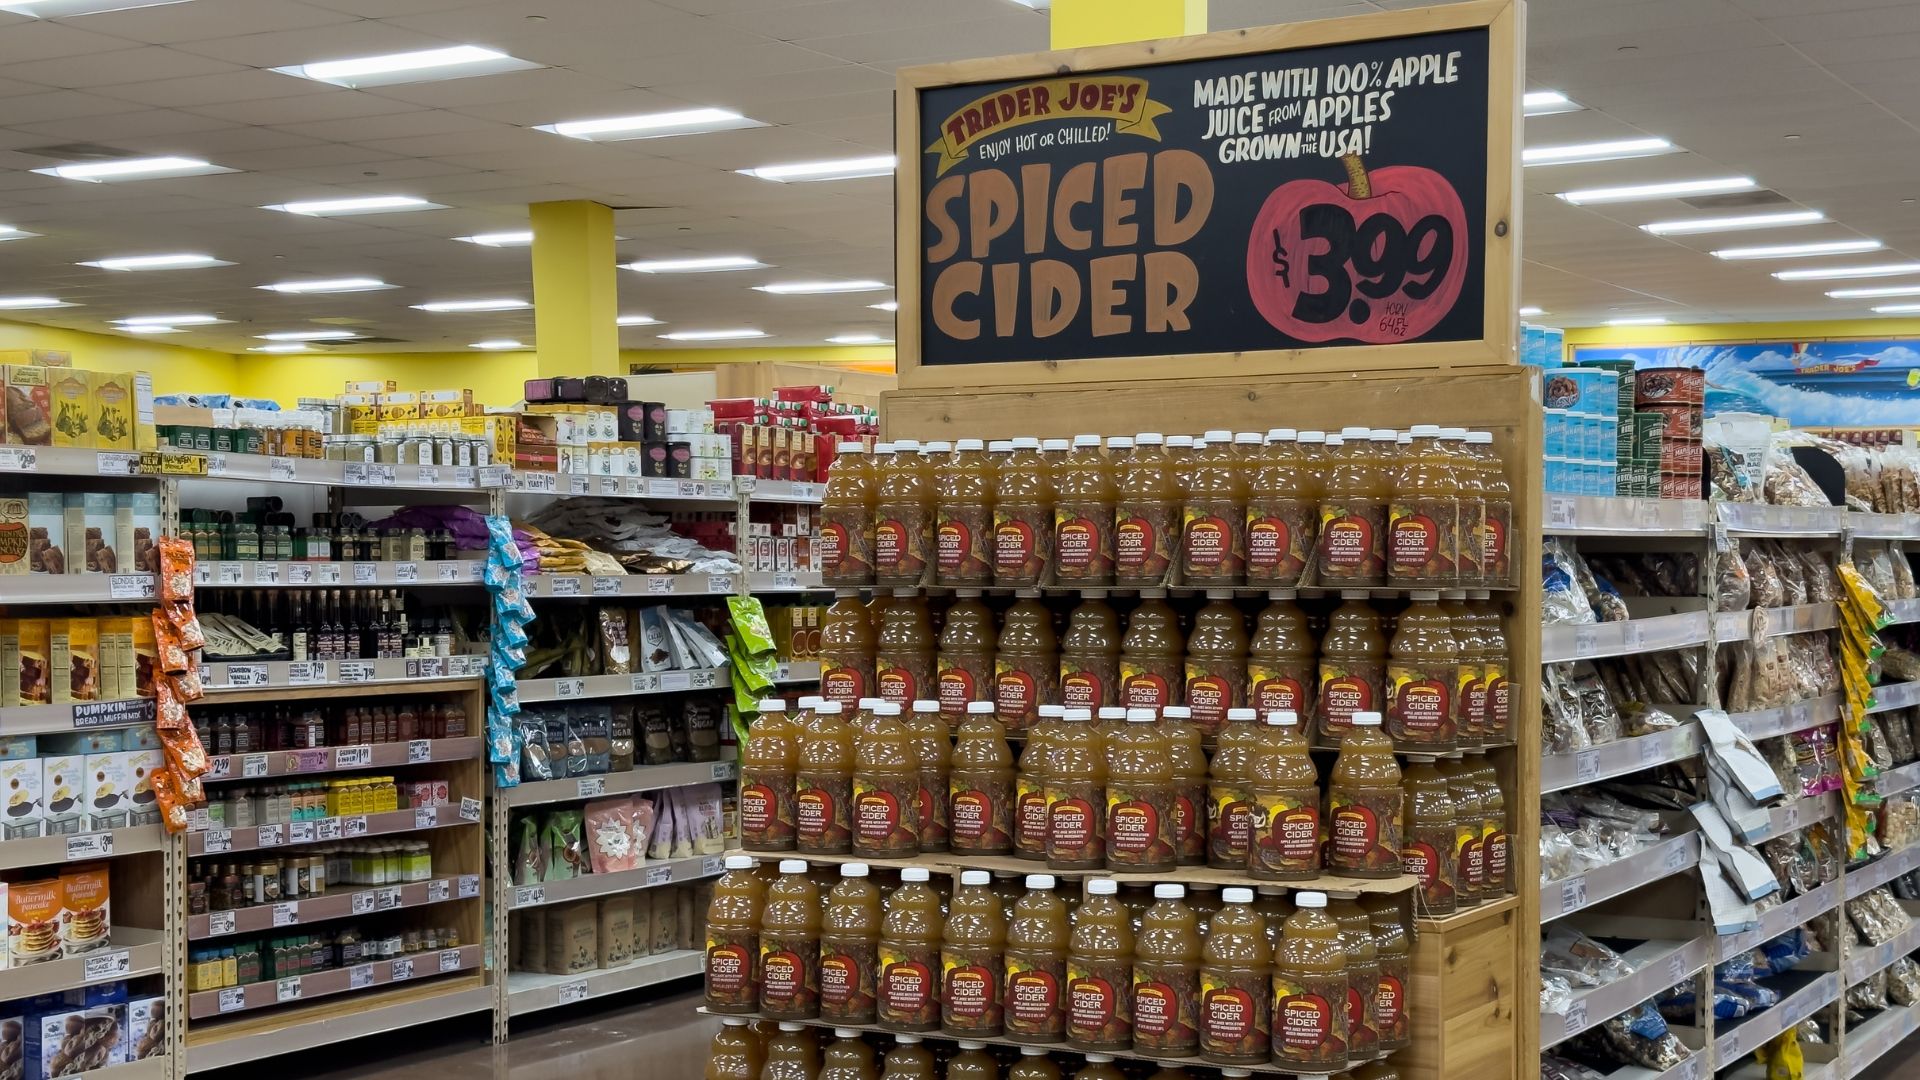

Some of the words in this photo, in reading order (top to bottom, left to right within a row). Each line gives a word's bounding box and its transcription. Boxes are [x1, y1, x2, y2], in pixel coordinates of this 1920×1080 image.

[1194, 72, 1258, 108] MADE
[1261, 67, 1318, 99] WITH
[1326, 61, 1384, 94] 100%
[1385, 51, 1461, 89] APPLE
[947, 86, 1050, 146] TRADER
[1059, 83, 1141, 113] JOE'S
[1201, 104, 1266, 140] JUICE
[1269, 101, 1300, 127] FROM
[1302, 91, 1395, 128] APPLES
[1306, 133, 1316, 142] IN
[1320, 125, 1372, 158] USA!
[980, 140, 1010, 162] ENJOY
[1016, 133, 1037, 152] HOT
[1058, 122, 1111, 144] CHILLED!
[1218, 132, 1302, 164] GROWN
[1301, 142, 1317, 155] THE
[926, 149, 1215, 263] SPICED
[932, 251, 1200, 340] CIDER
[1380, 318, 1394, 332] 64
[1801, 364, 1829, 374] TRADER
[1833, 365, 1856, 373] JOE'S
[997, 534, 1024, 542] SPICED
[1118, 532, 1144, 540] SPICED
[1251, 531, 1279, 539] SPICED
[1395, 530, 1427, 538] SPICED
[998, 541, 1021, 549] CIDER
[1063, 540, 1087, 548] CIDER
[1252, 539, 1276, 547] CIDER
[1333, 538, 1359, 546] CIDER
[880, 681, 906, 689] SPICED
[940, 681, 965, 689] SPICED
[999, 684, 1025, 692] SPICED
[829, 687, 852, 695] CIDER
[882, 688, 903, 696] CIDER
[941, 688, 962, 696] CIDER
[1065, 686, 1092, 694] SPICED
[1129, 687, 1159, 695] SPICED
[1191, 690, 1221, 698] SPICED
[1066, 692, 1090, 700] CIDER
[1261, 692, 1294, 700] SPICED
[1329, 691, 1361, 699] SPICED
[1193, 697, 1218, 705] CIDER
[76, 702, 126, 717] PUMPKIN
[1408, 702, 1437, 710] CIDER
[76, 716, 97, 726] BREAD
[104, 712, 127, 722] MUFFIN
[692, 719, 714, 728] SUGAR
[612, 728, 632, 736] UGAR
[859, 804, 890, 812] SPICED
[954, 804, 982, 812] SPICED
[1025, 812, 1044, 820] CIDE
[1053, 813, 1084, 821] SPICED
[1230, 814, 1248, 822] SPIC
[1114, 816, 1149, 825] SPICED
[1335, 820, 1368, 829] SPICED
[1055, 821, 1082, 829] CIDER
[1117, 823, 1145, 832] CIDER
[1232, 822, 1248, 830] CID
[1282, 822, 1314, 830] SPICED
[1285, 830, 1312, 839] CIDER
[1337, 828, 1363, 836] CIDER
[16, 890, 56, 904] Buttermilk
[711, 958, 741, 966] SPICED
[713, 965, 738, 973] CIDER
[765, 964, 794, 972] SPICED
[822, 968, 848, 976] SPICED
[767, 972, 791, 980] CIDER
[823, 975, 846, 984] CIDER
[891, 983, 918, 992] CIDER
[952, 980, 984, 988] SPICED
[954, 988, 981, 996] CIDER
[1014, 985, 1048, 993] SPICED
[1016, 993, 1044, 1001] CIDER
[1072, 992, 1104, 1001] SPICED
[1136, 996, 1166, 1005] SPICED
[1074, 1000, 1101, 1009] CIDER
[1138, 1004, 1162, 1013] CIDER
[1210, 1003, 1243, 1012] SPICED
[1211, 1011, 1240, 1020] CIDER
[1284, 1010, 1320, 1018] SPICED
[1287, 1018, 1317, 1027] CIDER
